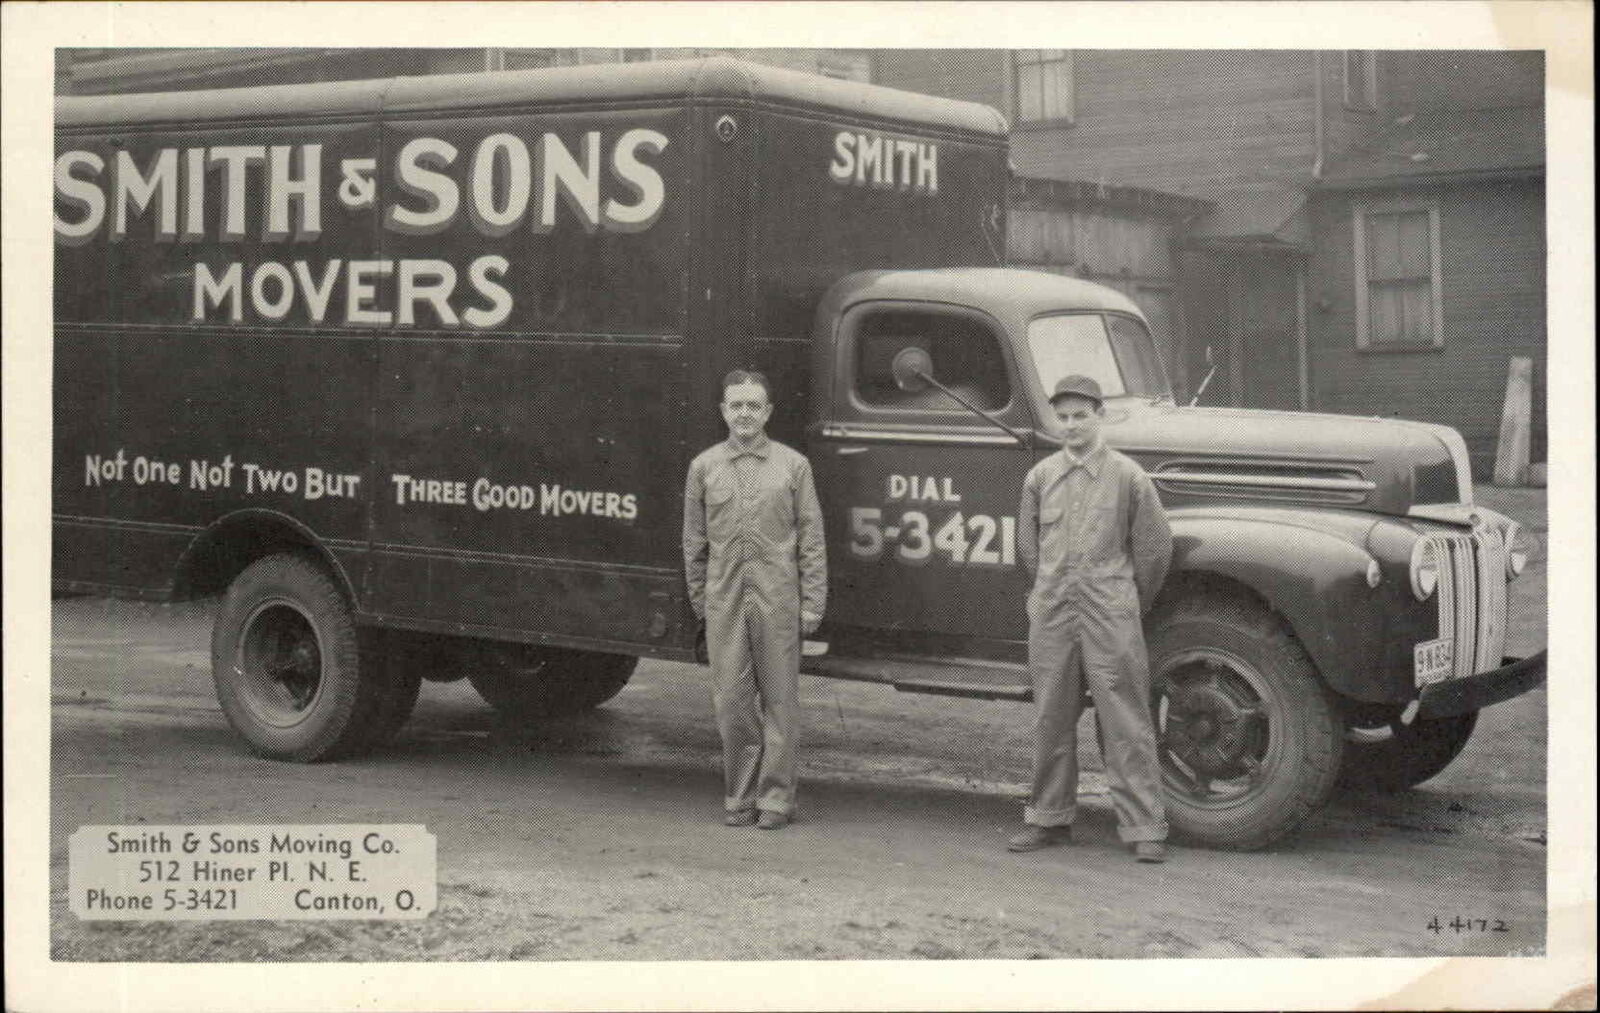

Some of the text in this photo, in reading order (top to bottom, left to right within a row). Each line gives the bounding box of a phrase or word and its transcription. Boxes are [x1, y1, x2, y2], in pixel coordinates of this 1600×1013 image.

[53, 128, 669, 238] SMITH & SONS
[830, 131, 939, 192] SMITH
[193, 254, 514, 328] MOVERS
[85, 447, 128, 486] Not
[133, 455, 182, 486] One
[189, 454, 235, 491] Not
[391, 473, 468, 505] THREE
[472, 477, 535, 512] GOOD
[540, 482, 639, 519] MOVERS
[888, 474, 962, 502] DIAL
[850, 506, 1016, 566] 5-3421
